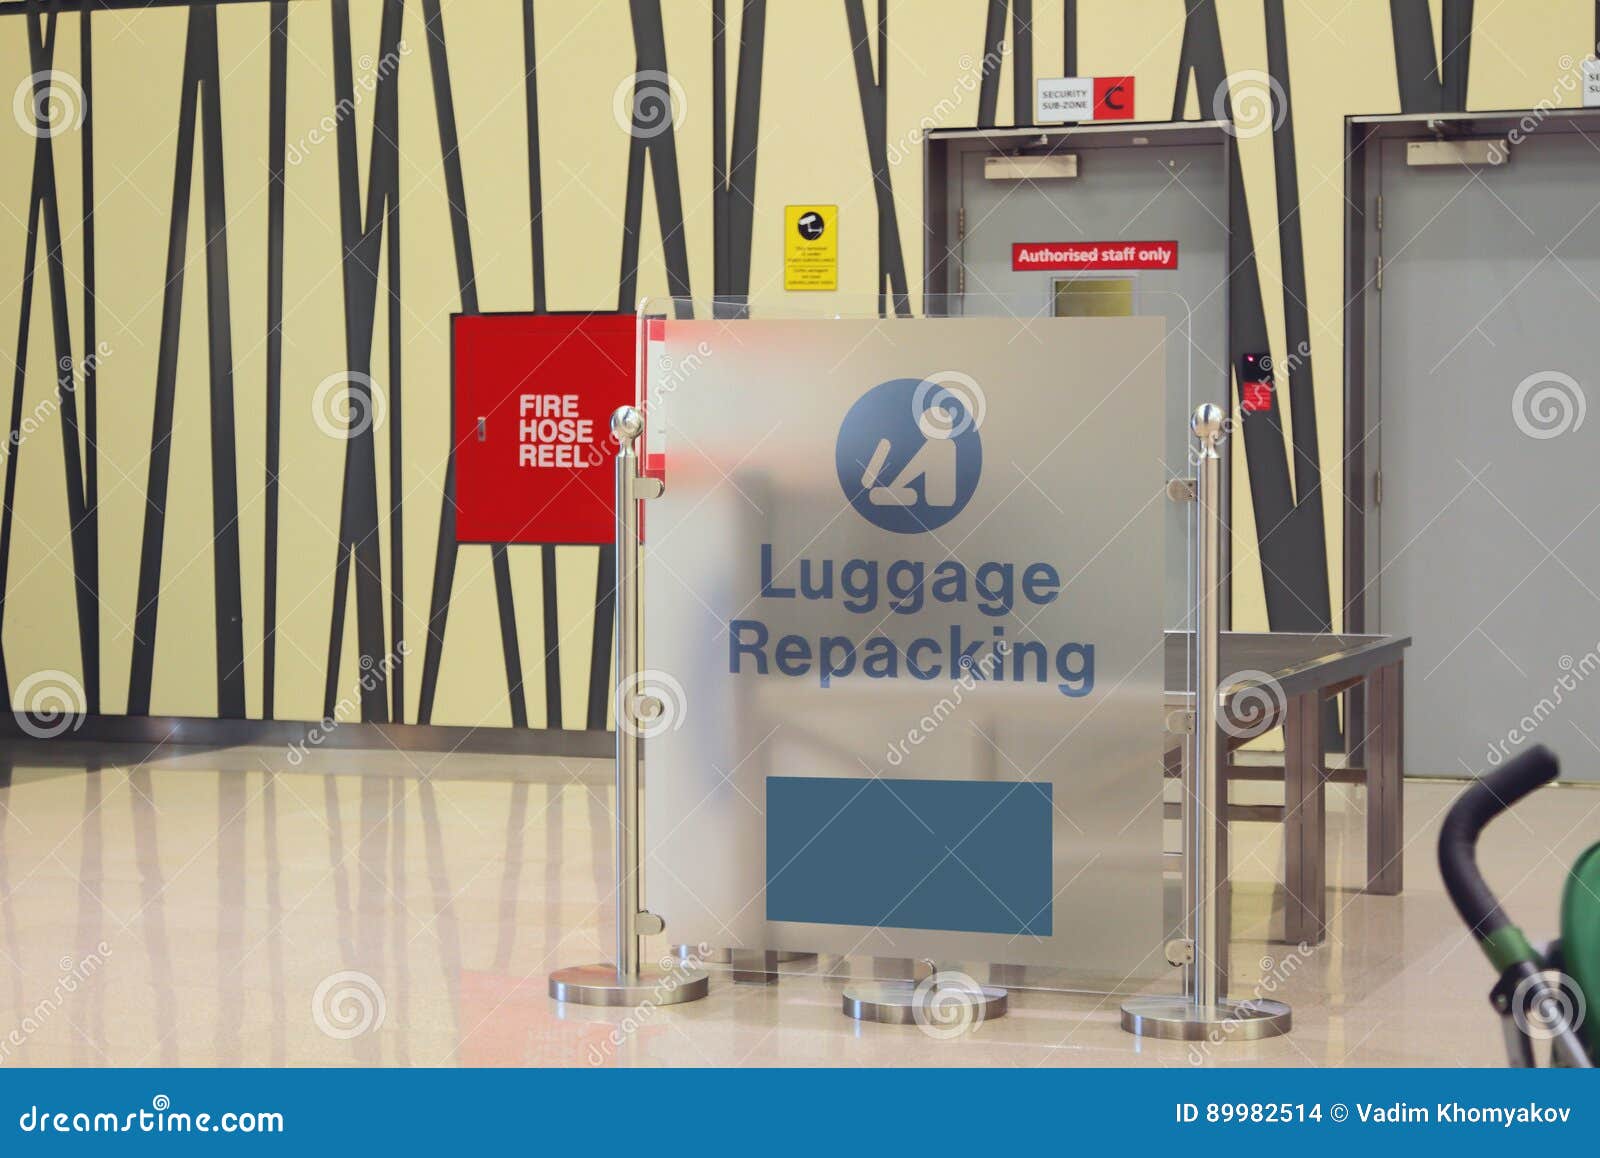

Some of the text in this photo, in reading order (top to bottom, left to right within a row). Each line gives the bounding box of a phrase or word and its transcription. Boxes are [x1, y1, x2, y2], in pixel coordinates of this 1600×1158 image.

[1042, 89, 1087, 99] SECURITY
[1042, 100, 1087, 110] SUB-ZONE
[1103, 86, 1124, 110] C
[1018, 247, 1171, 264] Authorised staff only
[519, 394, 579, 418] FIRE
[519, 418, 594, 443] HOSE
[519, 443, 590, 468] REEL
[760, 543, 1061, 617] Luggage
[728, 619, 1096, 698] Repacking
